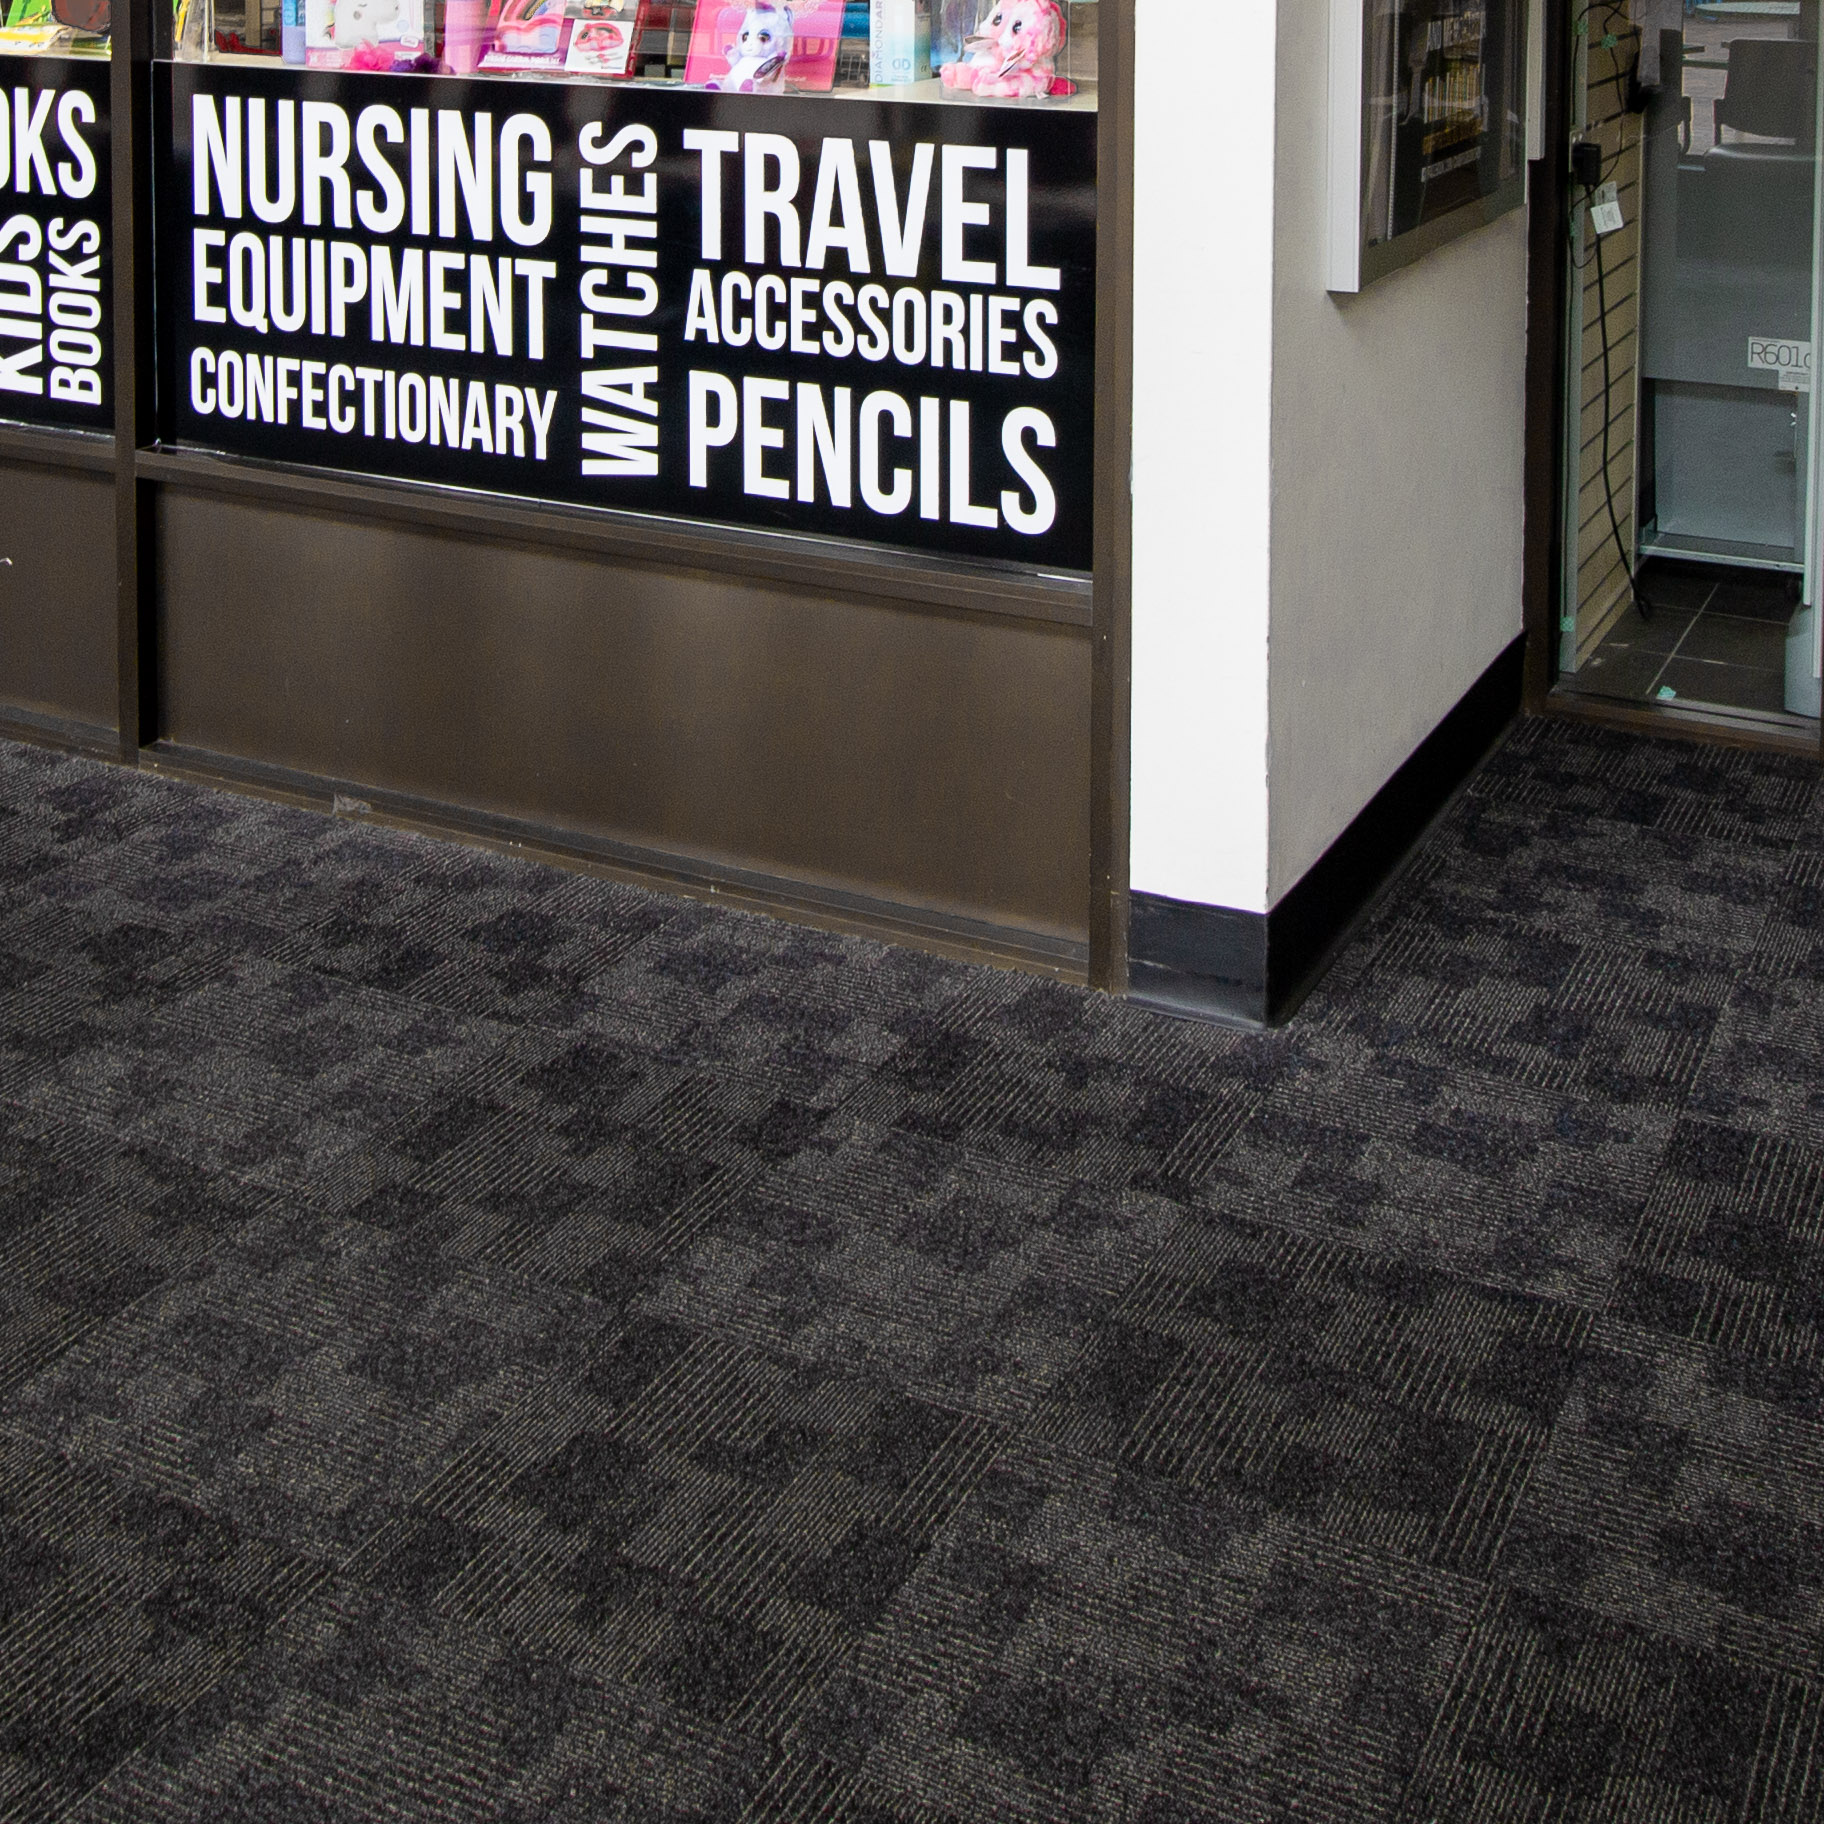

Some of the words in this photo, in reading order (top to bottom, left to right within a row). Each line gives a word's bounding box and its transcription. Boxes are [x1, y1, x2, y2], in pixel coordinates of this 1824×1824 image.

[190, 93, 554, 247] NURSING
[683, 128, 1063, 291] TRAVEL
[48, 216, 103, 407] BOOKS
[192, 228, 558, 361] EQUIPMENT
[579, 120, 660, 478] WATCHES
[683, 269, 1059, 379] ACCESSORIES
[189, 345, 559, 461] CONFECTIONARY
[687, 369, 1058, 536] PENCILS
